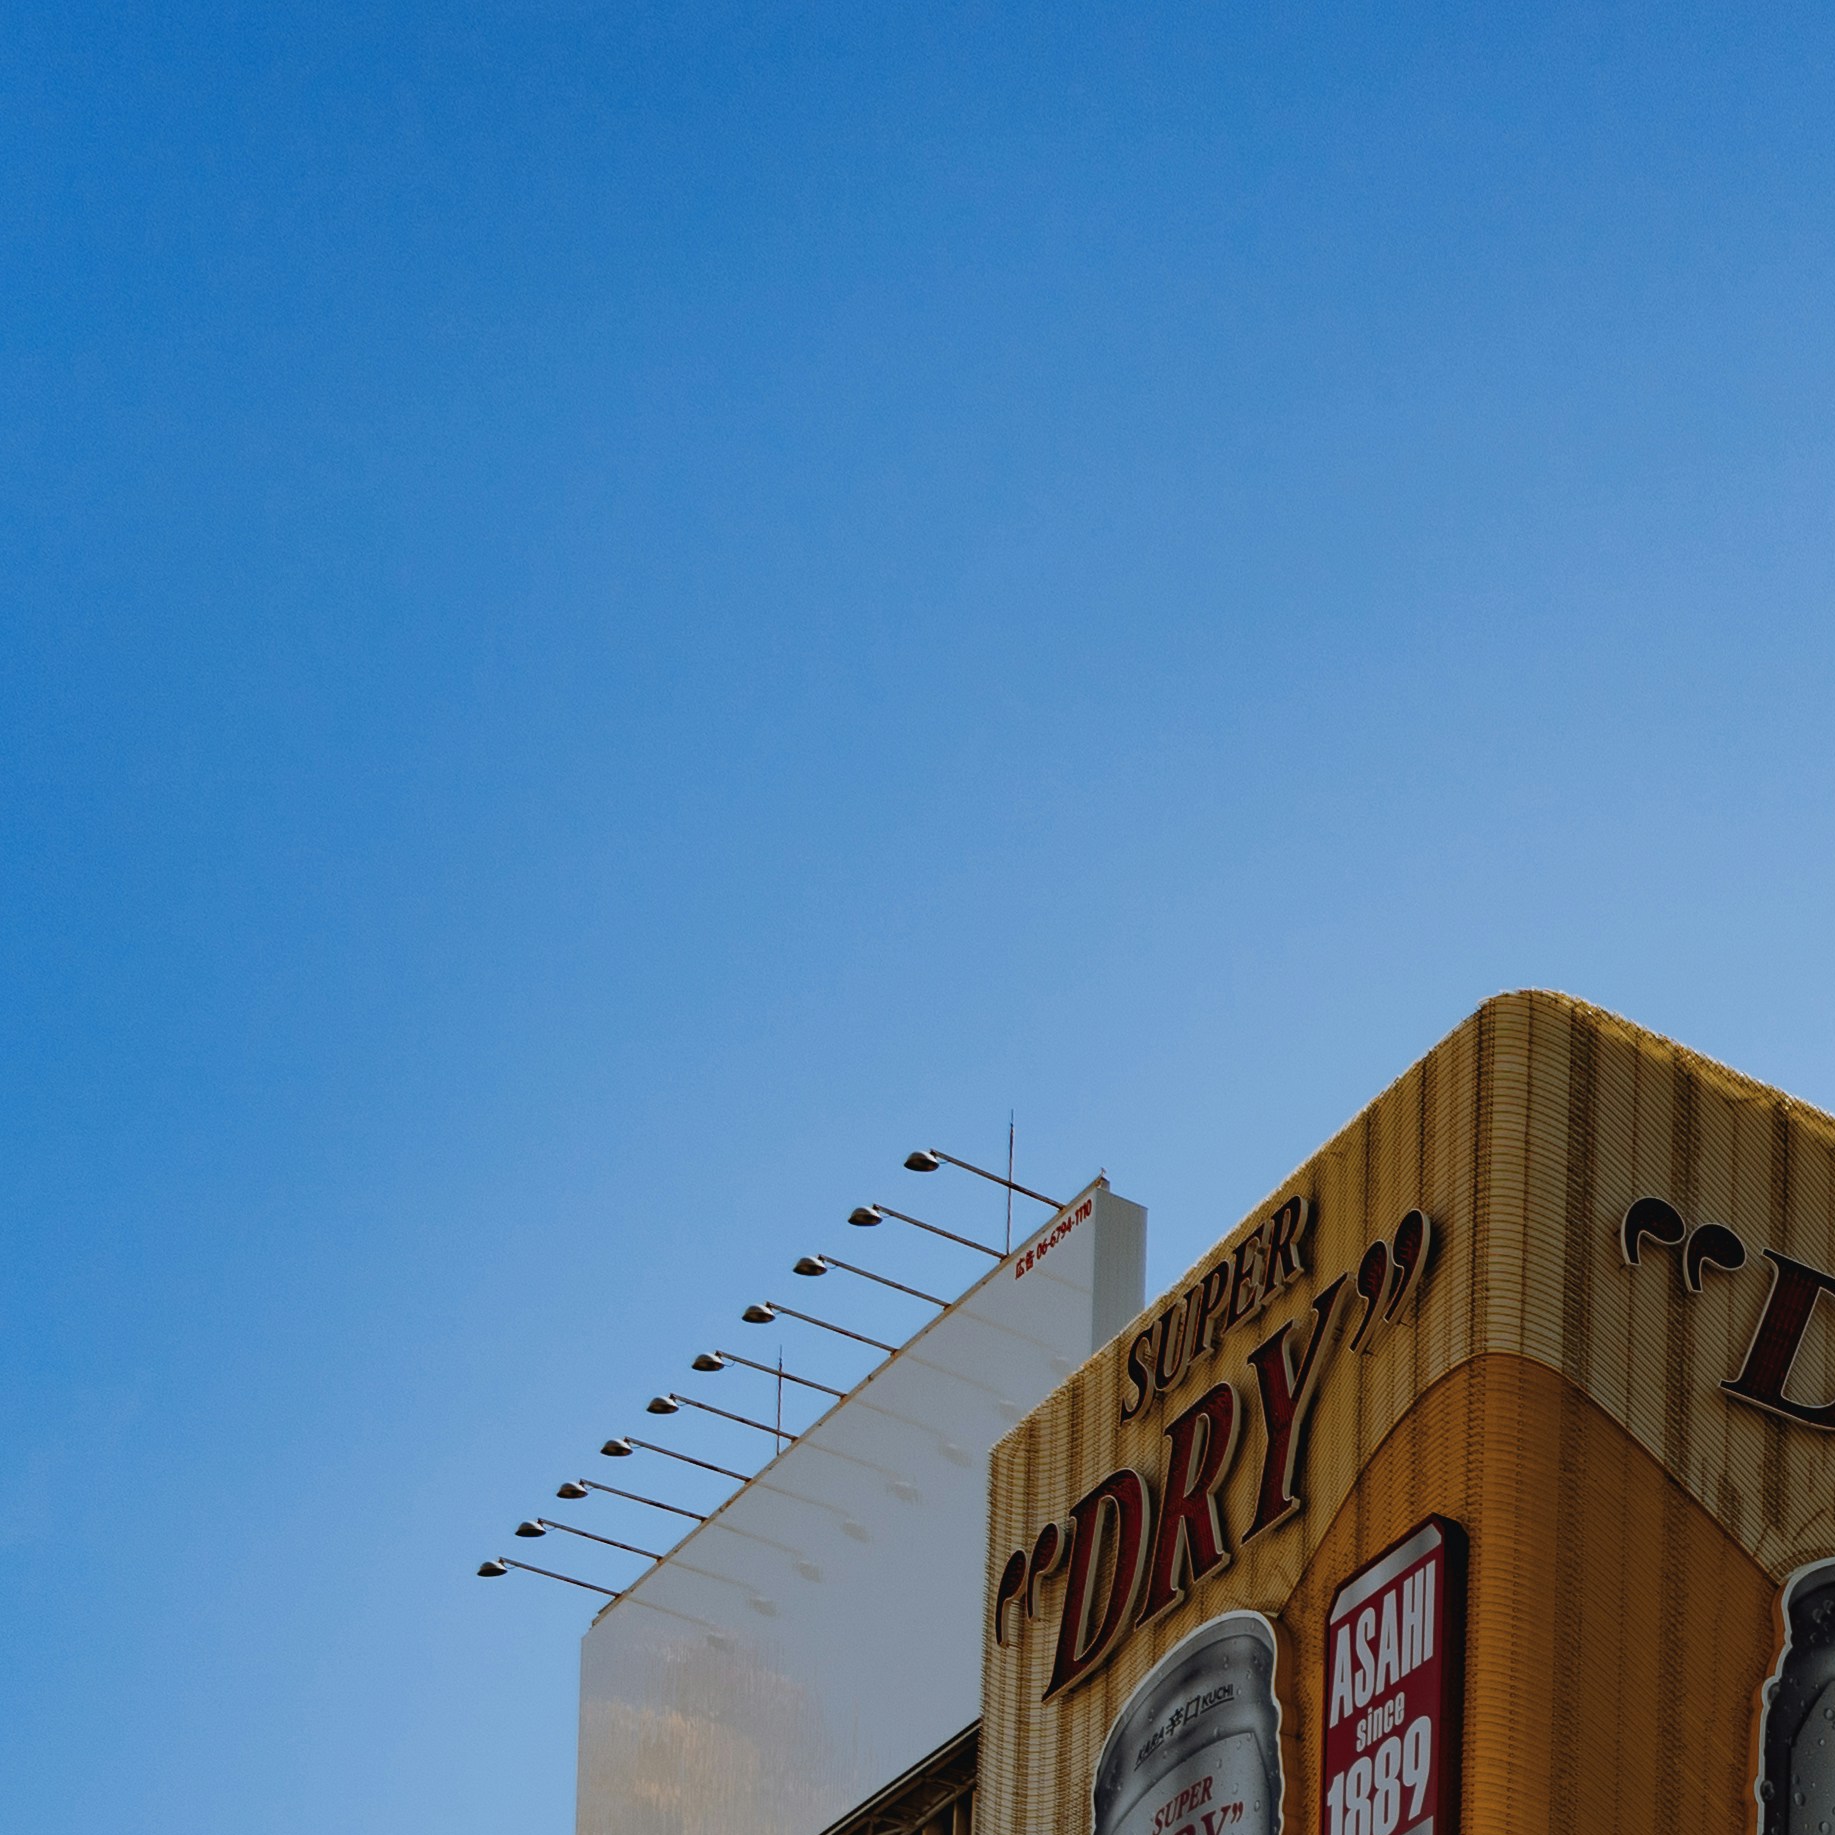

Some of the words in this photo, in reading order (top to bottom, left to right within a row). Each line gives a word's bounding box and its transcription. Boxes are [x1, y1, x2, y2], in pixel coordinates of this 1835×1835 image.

[1121, 1195, 1315, 1424] SUPER
[1201, 1683, 1234, 1709] KUCHI
[1329, 1559, 1436, 1728] ASAHI
[1356, 1691, 1405, 1753] since
